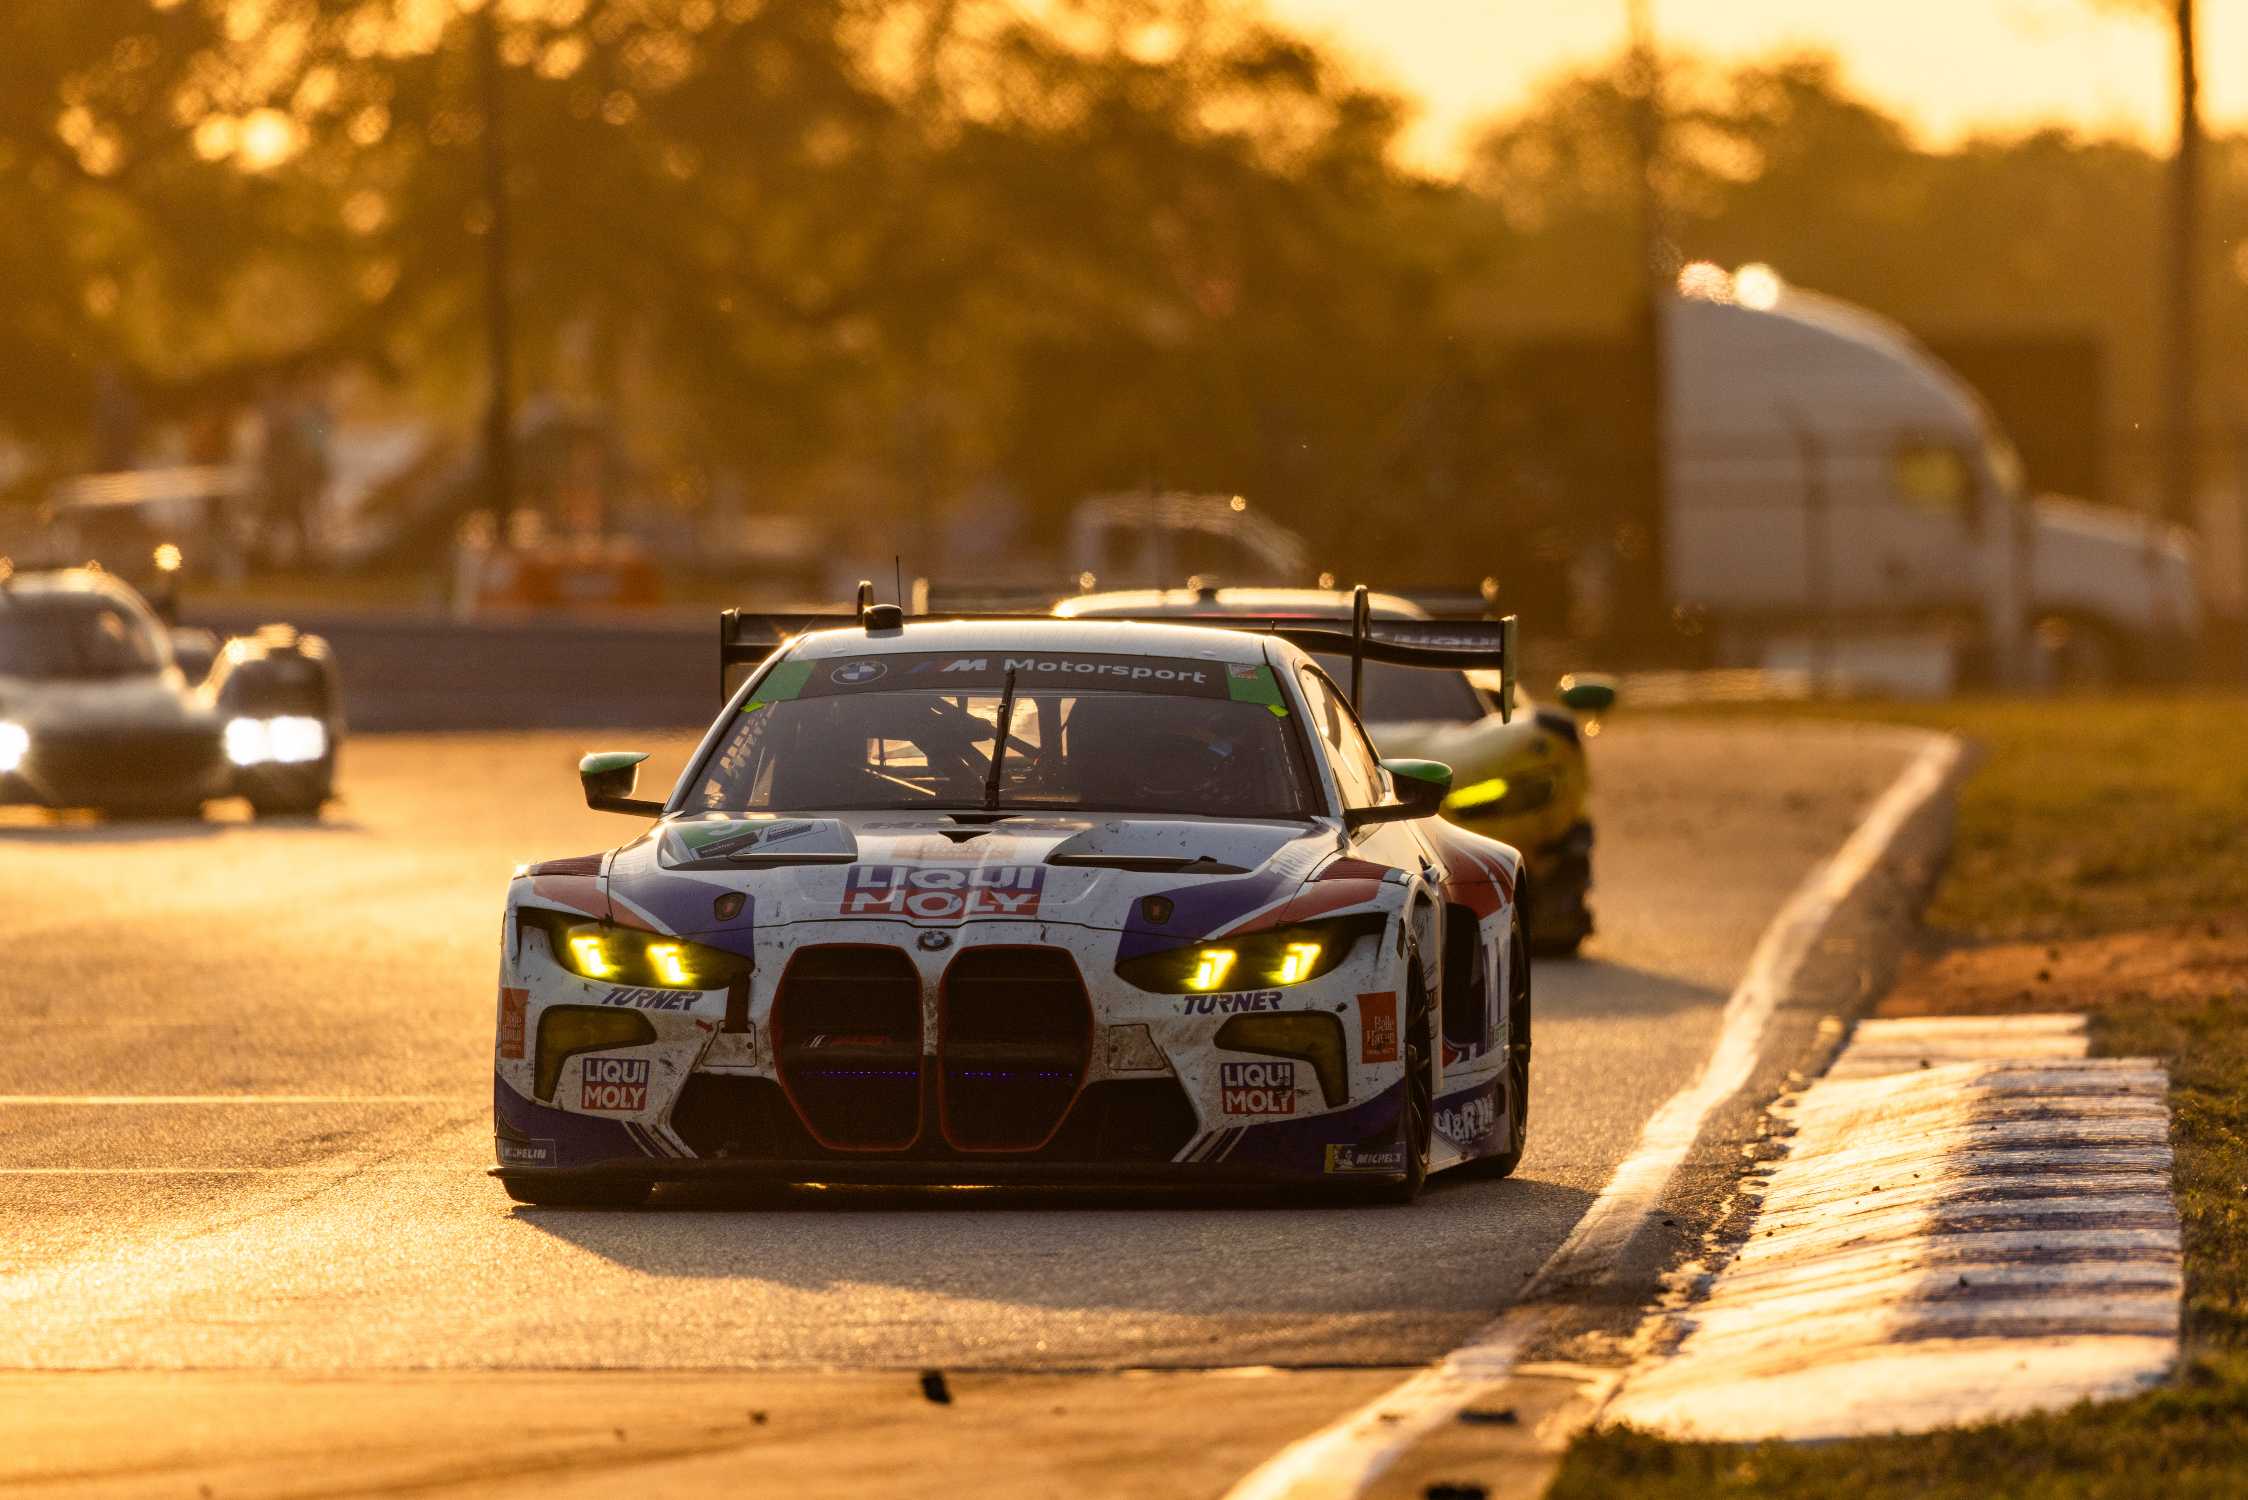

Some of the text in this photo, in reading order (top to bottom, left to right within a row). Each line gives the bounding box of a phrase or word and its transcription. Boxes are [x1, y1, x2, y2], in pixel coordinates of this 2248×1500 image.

[1003, 657, 1207, 684] Motorsport
[856, 867, 1036, 889] LIQUI
[853, 889, 1039, 916] MOLY
[602, 986, 704, 1011] TURNER
[1183, 991, 1283, 1015] TURNER
[585, 1060, 647, 1084] LIQUI
[1223, 1063, 1291, 1088] LIQUI
[583, 1084, 646, 1109] MOLY
[1226, 1089, 1294, 1113] MOLY
